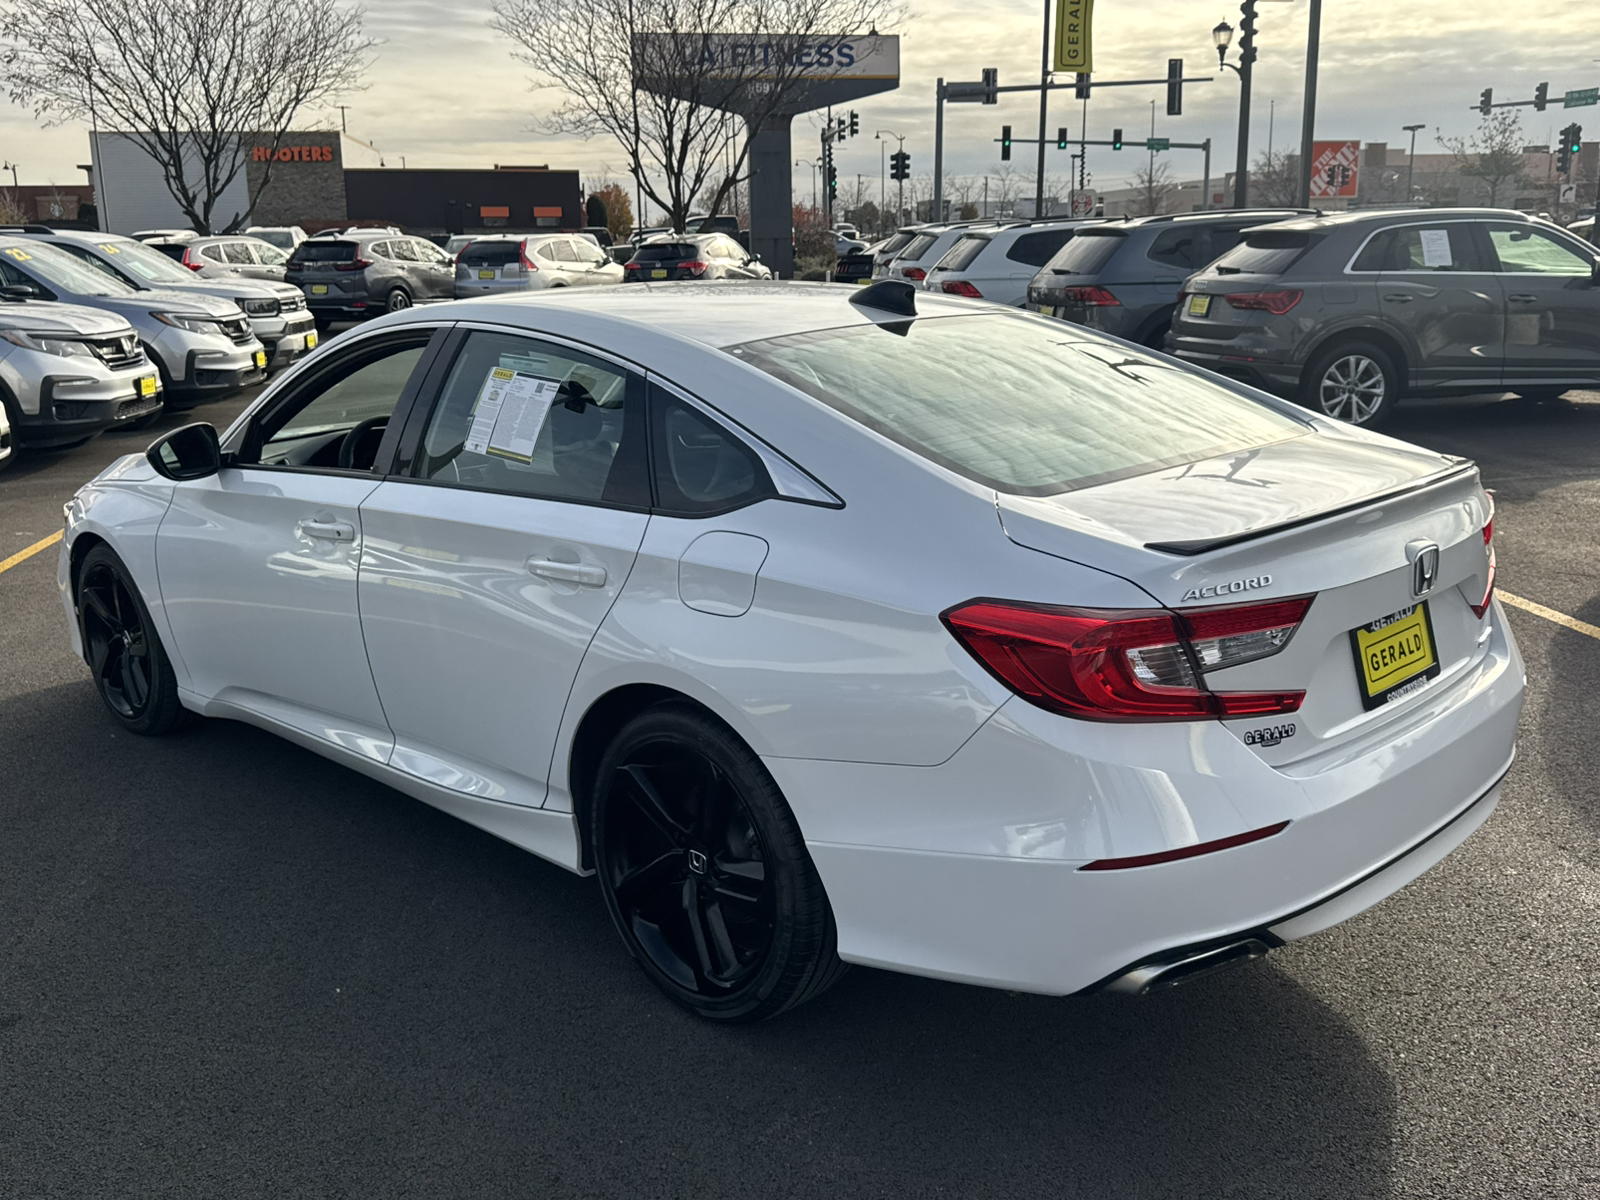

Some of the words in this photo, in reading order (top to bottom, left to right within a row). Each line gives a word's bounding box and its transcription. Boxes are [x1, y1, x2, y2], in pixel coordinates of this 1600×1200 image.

[252, 146, 333, 162] HOOTERS
[1181, 574, 1273, 602] ACCORD
[1370, 633, 1421, 672] GERALD
[1244, 723, 1296, 745] GERALD
